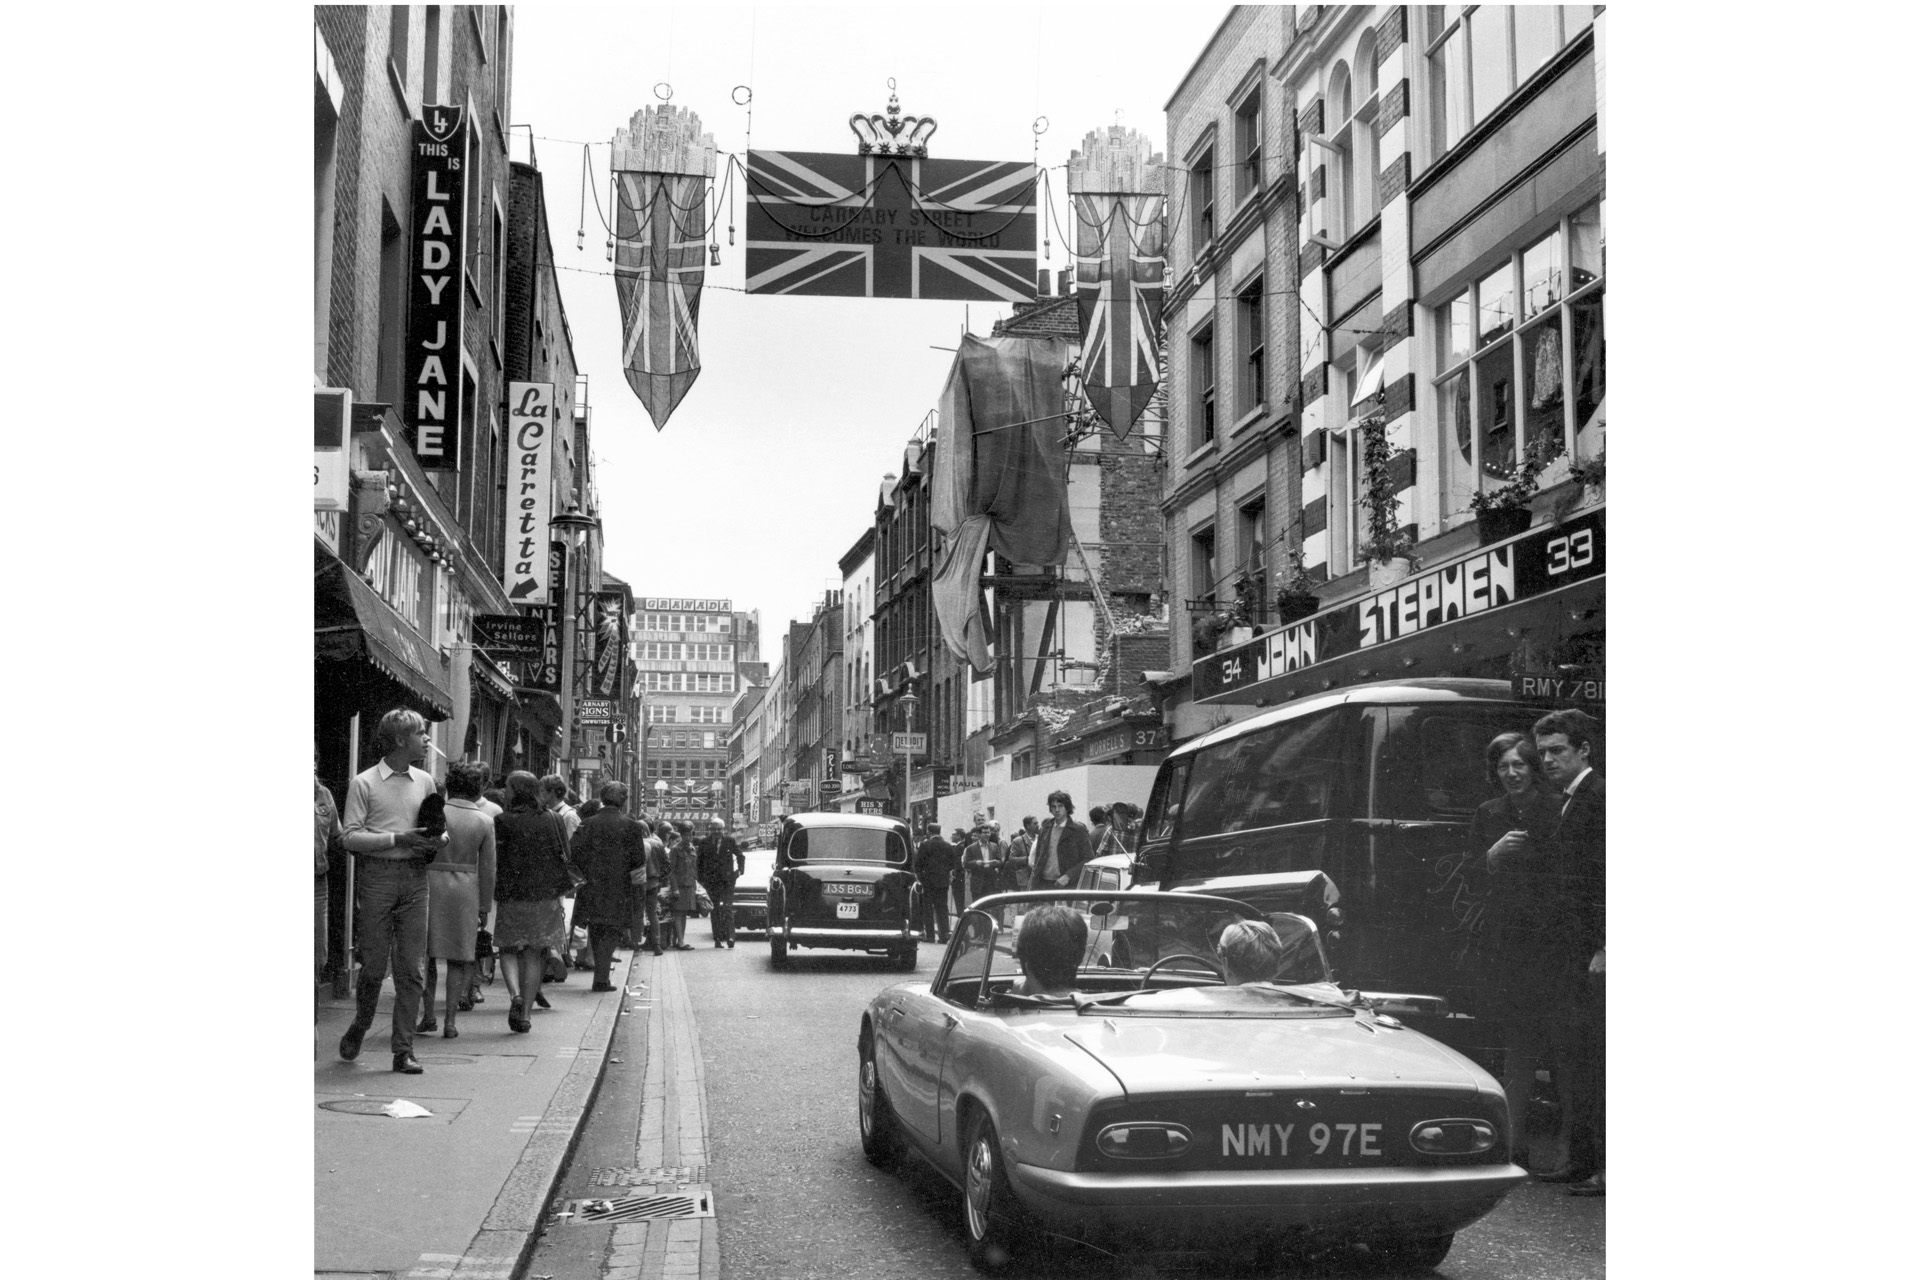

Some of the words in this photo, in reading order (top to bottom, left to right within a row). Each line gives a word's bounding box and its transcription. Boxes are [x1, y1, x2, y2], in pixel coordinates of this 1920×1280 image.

[418, 143, 449, 157] THIS
[448, 157, 461, 170] IS
[809, 205, 898, 227] CARNABY
[909, 208, 974, 228] STREET
[422, 171, 452, 305] LADY
[786, 223, 883, 245] WELCOMES
[893, 228, 927, 247] THE
[938, 229, 1001, 249] WORLD
[417, 320, 448, 456] JANE
[511, 387, 548, 418] La
[514, 420, 545, 575] Carretta
[1546, 528, 1593, 576] 33
[647, 599, 730, 611] GRANADA
[1222, 658, 1242, 685] 34
[1257, 620, 1316, 682] JOHN
[1359, 543, 1516, 649] STEPHEN
[486, 621, 522, 631] Irvine
[545, 551, 561, 684] SELLARS
[494, 631, 537, 641] Sellars
[1522, 677, 1564, 698] RMY
[1570, 680, 1603, 700] 781
[582, 707, 609, 717] SIGNS
[1135, 730, 1157, 745] 37
[862, 807, 883, 815] HERS
[827, 884, 845, 894] 135
[847, 884, 869, 894] BGJ
[839, 905, 857, 913] 4773
[1222, 1123, 1295, 1157] NMY
[1308, 1122, 1383, 1156] 97E
